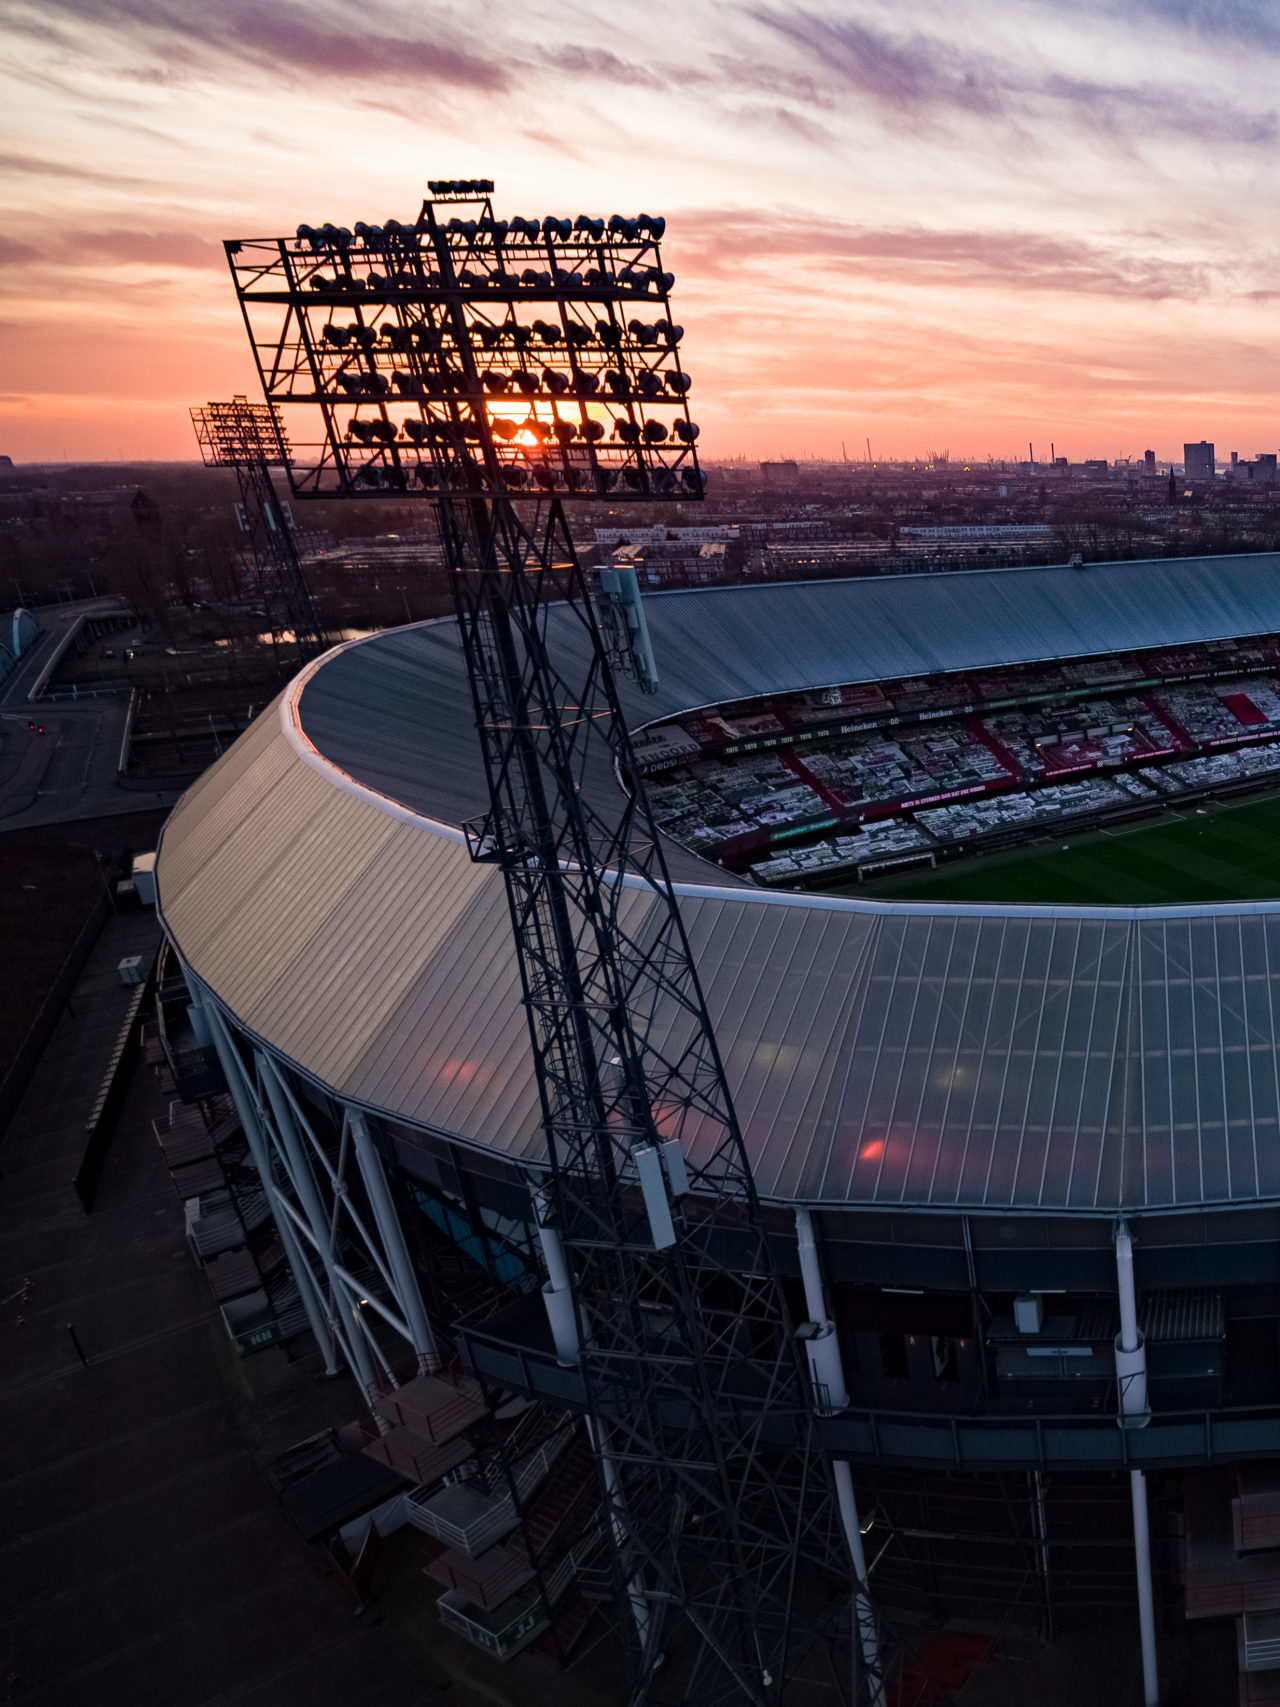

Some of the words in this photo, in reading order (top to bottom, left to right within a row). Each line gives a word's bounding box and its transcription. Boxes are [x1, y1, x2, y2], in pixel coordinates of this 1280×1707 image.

[919, 710, 953, 720] Heineken
[841, 721, 878, 734] Heineken
[650, 760, 678, 773] pepsi
